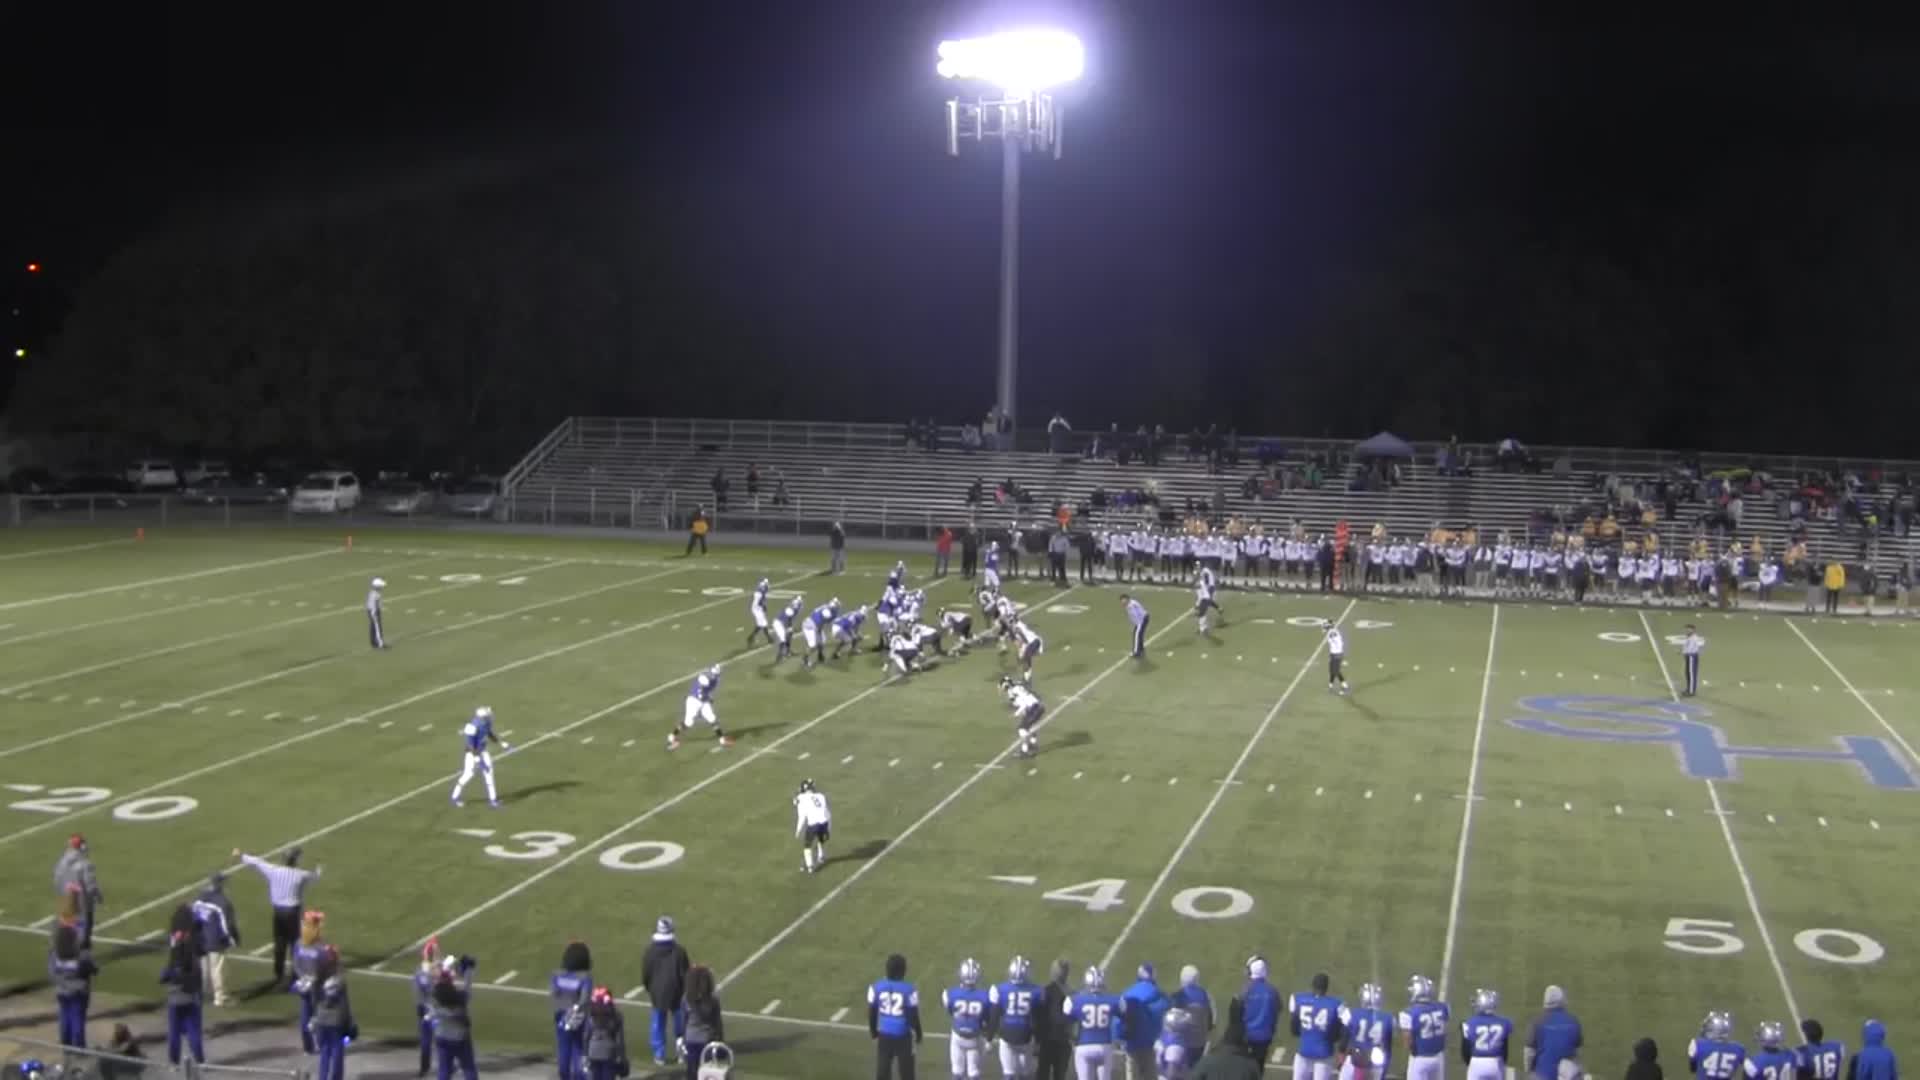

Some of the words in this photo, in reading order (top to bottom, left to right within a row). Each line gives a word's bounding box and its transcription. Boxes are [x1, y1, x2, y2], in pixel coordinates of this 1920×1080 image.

[1505, 695, 1919, 790] SH
[8, 786, 199, 821] 20
[484, 830, 686, 870] 30
[1042, 878, 1255, 919] 40
[1662, 917, 1886, 964] 50
[879, 991, 904, 1016] 32
[1006, 991, 1031, 1016] 15
[1081, 1003, 1111, 1028] 36
[1299, 1004, 1329, 1032] 54
[1355, 1018, 1383, 1044] 14
[1419, 1010, 1444, 1039] 25
[1475, 1024, 1504, 1051] 27
[1703, 1050, 1737, 1078] 45
[1813, 1051, 1837, 1079] 16
